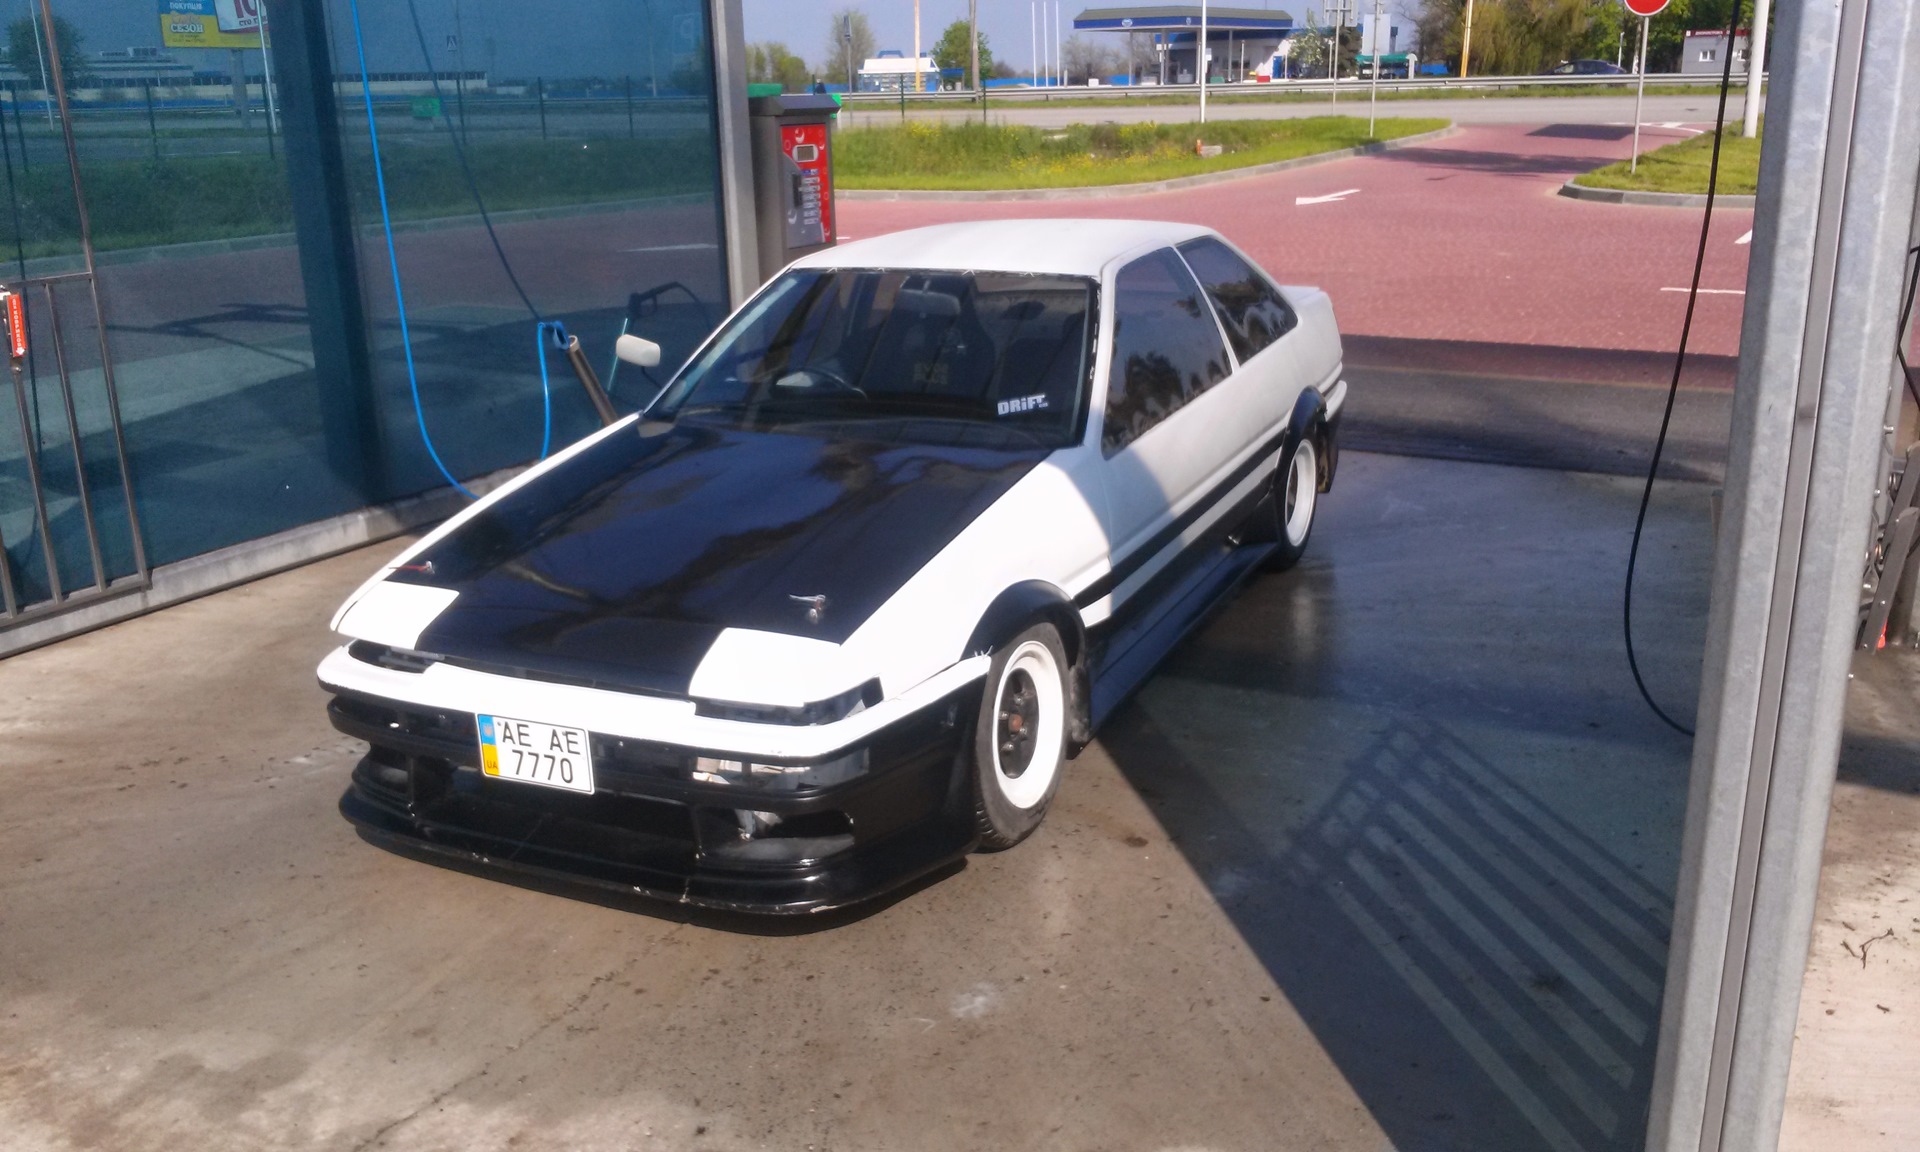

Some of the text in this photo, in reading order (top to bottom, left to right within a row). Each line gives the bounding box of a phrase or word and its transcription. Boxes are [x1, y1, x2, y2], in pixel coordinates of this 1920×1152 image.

[170, 23, 204, 33] СЕЗОН
[502, 721, 581, 755] AE AE
[486, 760, 499, 769] UA
[512, 749, 573, 784] 7770
